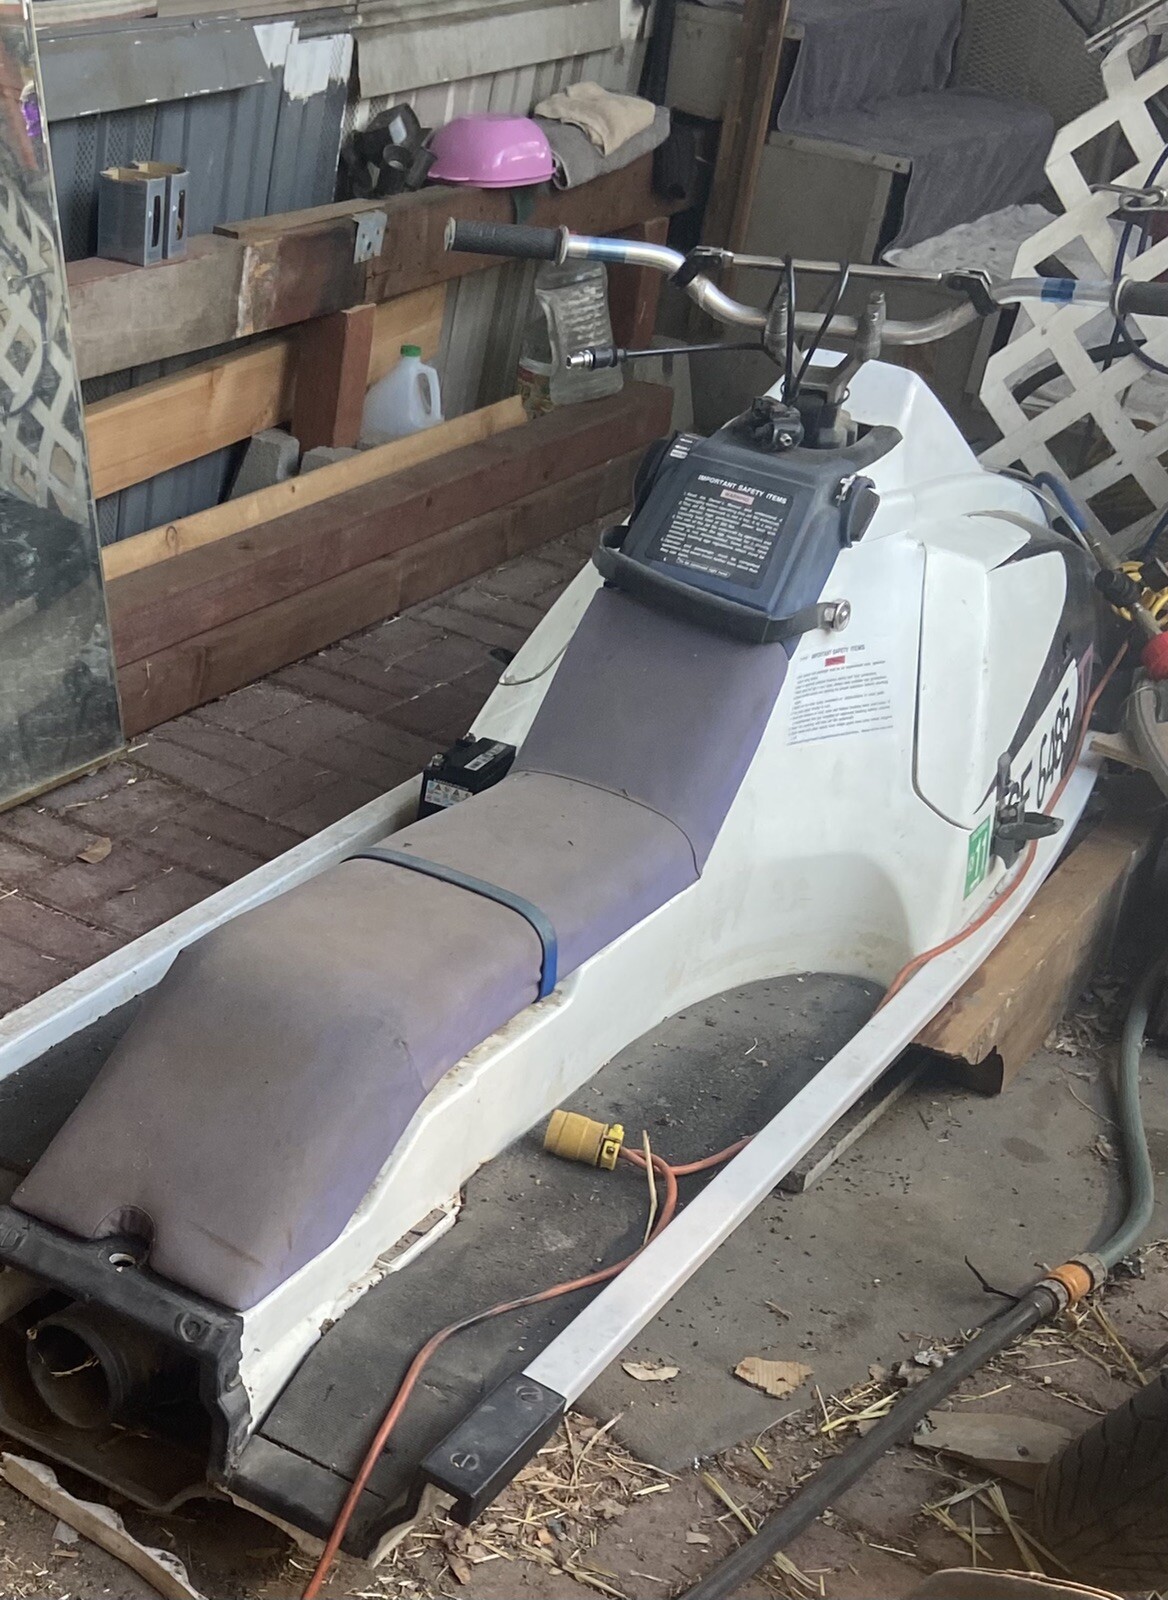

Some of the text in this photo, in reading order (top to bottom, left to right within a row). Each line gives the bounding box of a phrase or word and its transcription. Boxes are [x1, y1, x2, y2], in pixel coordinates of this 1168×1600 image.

[698, 475, 787, 505] IMPORTANT SAFETY ITEMS
